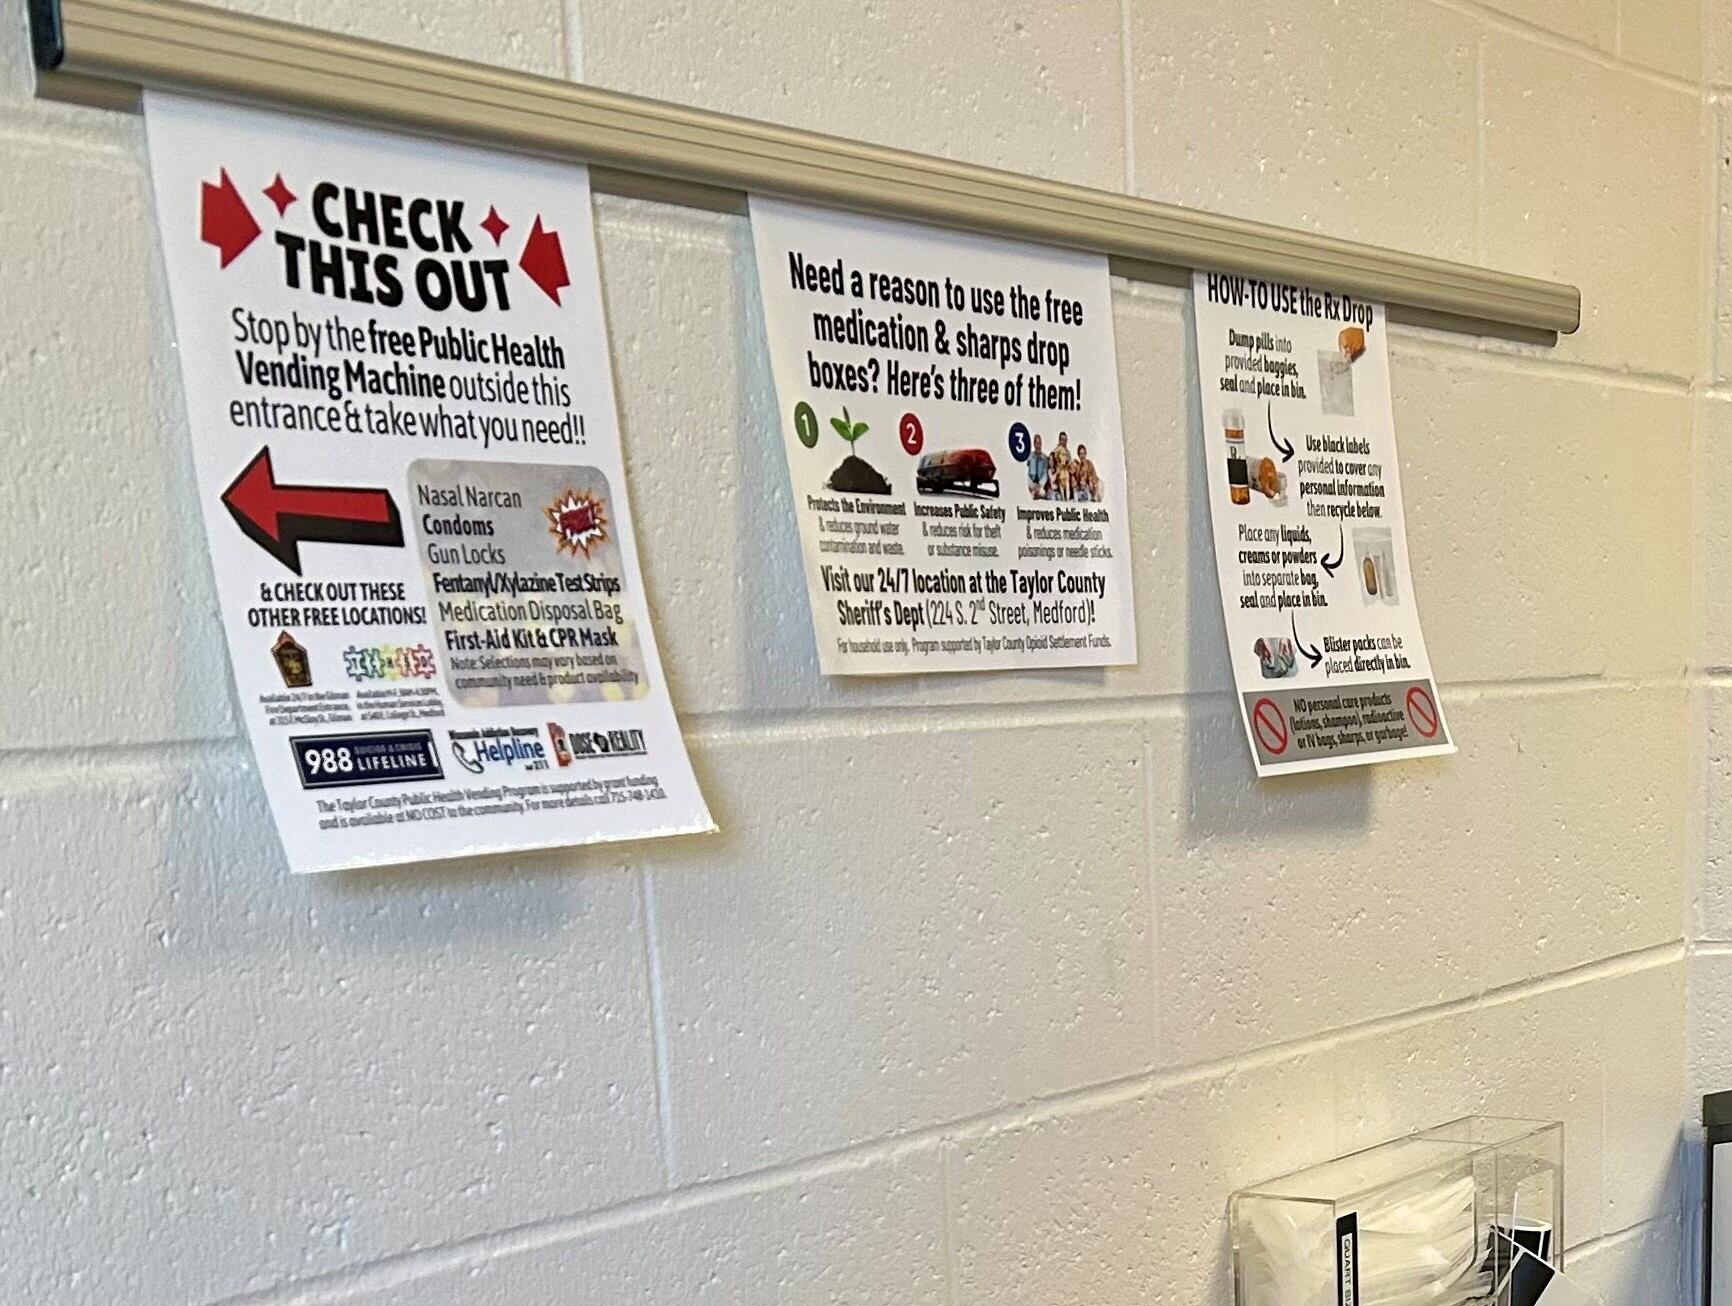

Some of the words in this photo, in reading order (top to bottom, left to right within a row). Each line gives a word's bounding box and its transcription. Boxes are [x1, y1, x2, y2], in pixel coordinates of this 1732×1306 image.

[311, 181, 474, 254] CHECK
[274, 230, 404, 305] THIS
[416, 258, 509, 313] OUT
[789, 251, 844, 296] Need
[851, 268, 863, 298] a
[870, 272, 939, 308] reason
[945, 276, 964, 311] to
[971, 286, 1004, 315] use
[1010, 285, 1040, 319] the
[1045, 289, 1083, 326] free
[1207, 272, 1268, 308] HOW-TO
[1270, 282, 1297, 313] USE
[1300, 288, 1321, 318] the
[1324, 292, 1339, 320] Rx
[1342, 295, 1373, 331] Drop
[232, 307, 289, 356] Stop
[294, 316, 322, 358] by
[326, 319, 364, 352] the
[368, 319, 415, 358] free
[419, 326, 487, 365] Public
[492, 332, 565, 369] Health
[813, 308, 928, 354] medication
[934, 319, 950, 355] &
[956, 325, 1021, 368] sharps
[1027, 331, 1069, 375] drop
[235, 350, 341, 398] Vending
[344, 360, 445, 399] Machine
[450, 368, 528, 404] outside
[531, 376, 571, 407] this
[808, 351, 879, 391] boxes?
[887, 359, 944, 399] Here's
[950, 368, 998, 404] three
[1005, 373, 1024, 406] of
[1029, 377, 1081, 411] them!
[230, 396, 340, 433] entrance
[344, 403, 363, 433] &
[365, 403, 417, 436] take
[420, 408, 478, 439] what
[482, 417, 519, 448] you
[522, 413, 586, 446] need!!
[800, 411, 812, 437] 1
[907, 424, 916, 445] 2
[1015, 432, 1025, 453] 3
[418, 484, 463, 507] Nasal
[466, 486, 522, 509] Narcan
[423, 514, 494, 537] Condoms
[428, 544, 457, 565] Gun
[460, 544, 505, 565] Locks
[260, 582, 272, 601] &
[275, 582, 324, 601] CHECK
[328, 583, 357, 601] OUT
[359, 583, 405, 600] THESE
[821, 563, 851, 593] Visit
[854, 570, 875, 594] our
[877, 566, 909, 593] 24/7
[912, 566, 966, 594] location
[969, 568, 982, 593] at
[985, 568, 1007, 594] the
[1010, 568, 1053, 594] Taylor
[1057, 570, 1105, 598] County
[248, 607, 301, 627] OTHER
[304, 607, 340, 626] FREE
[342, 606, 427, 625] LOCATIONS!
[305, 749, 353, 775] 988
[357, 752, 427, 770] LIFELINE
[475, 739, 545, 763] Helpline
[1343, 1237, 1351, 1284] QUART
